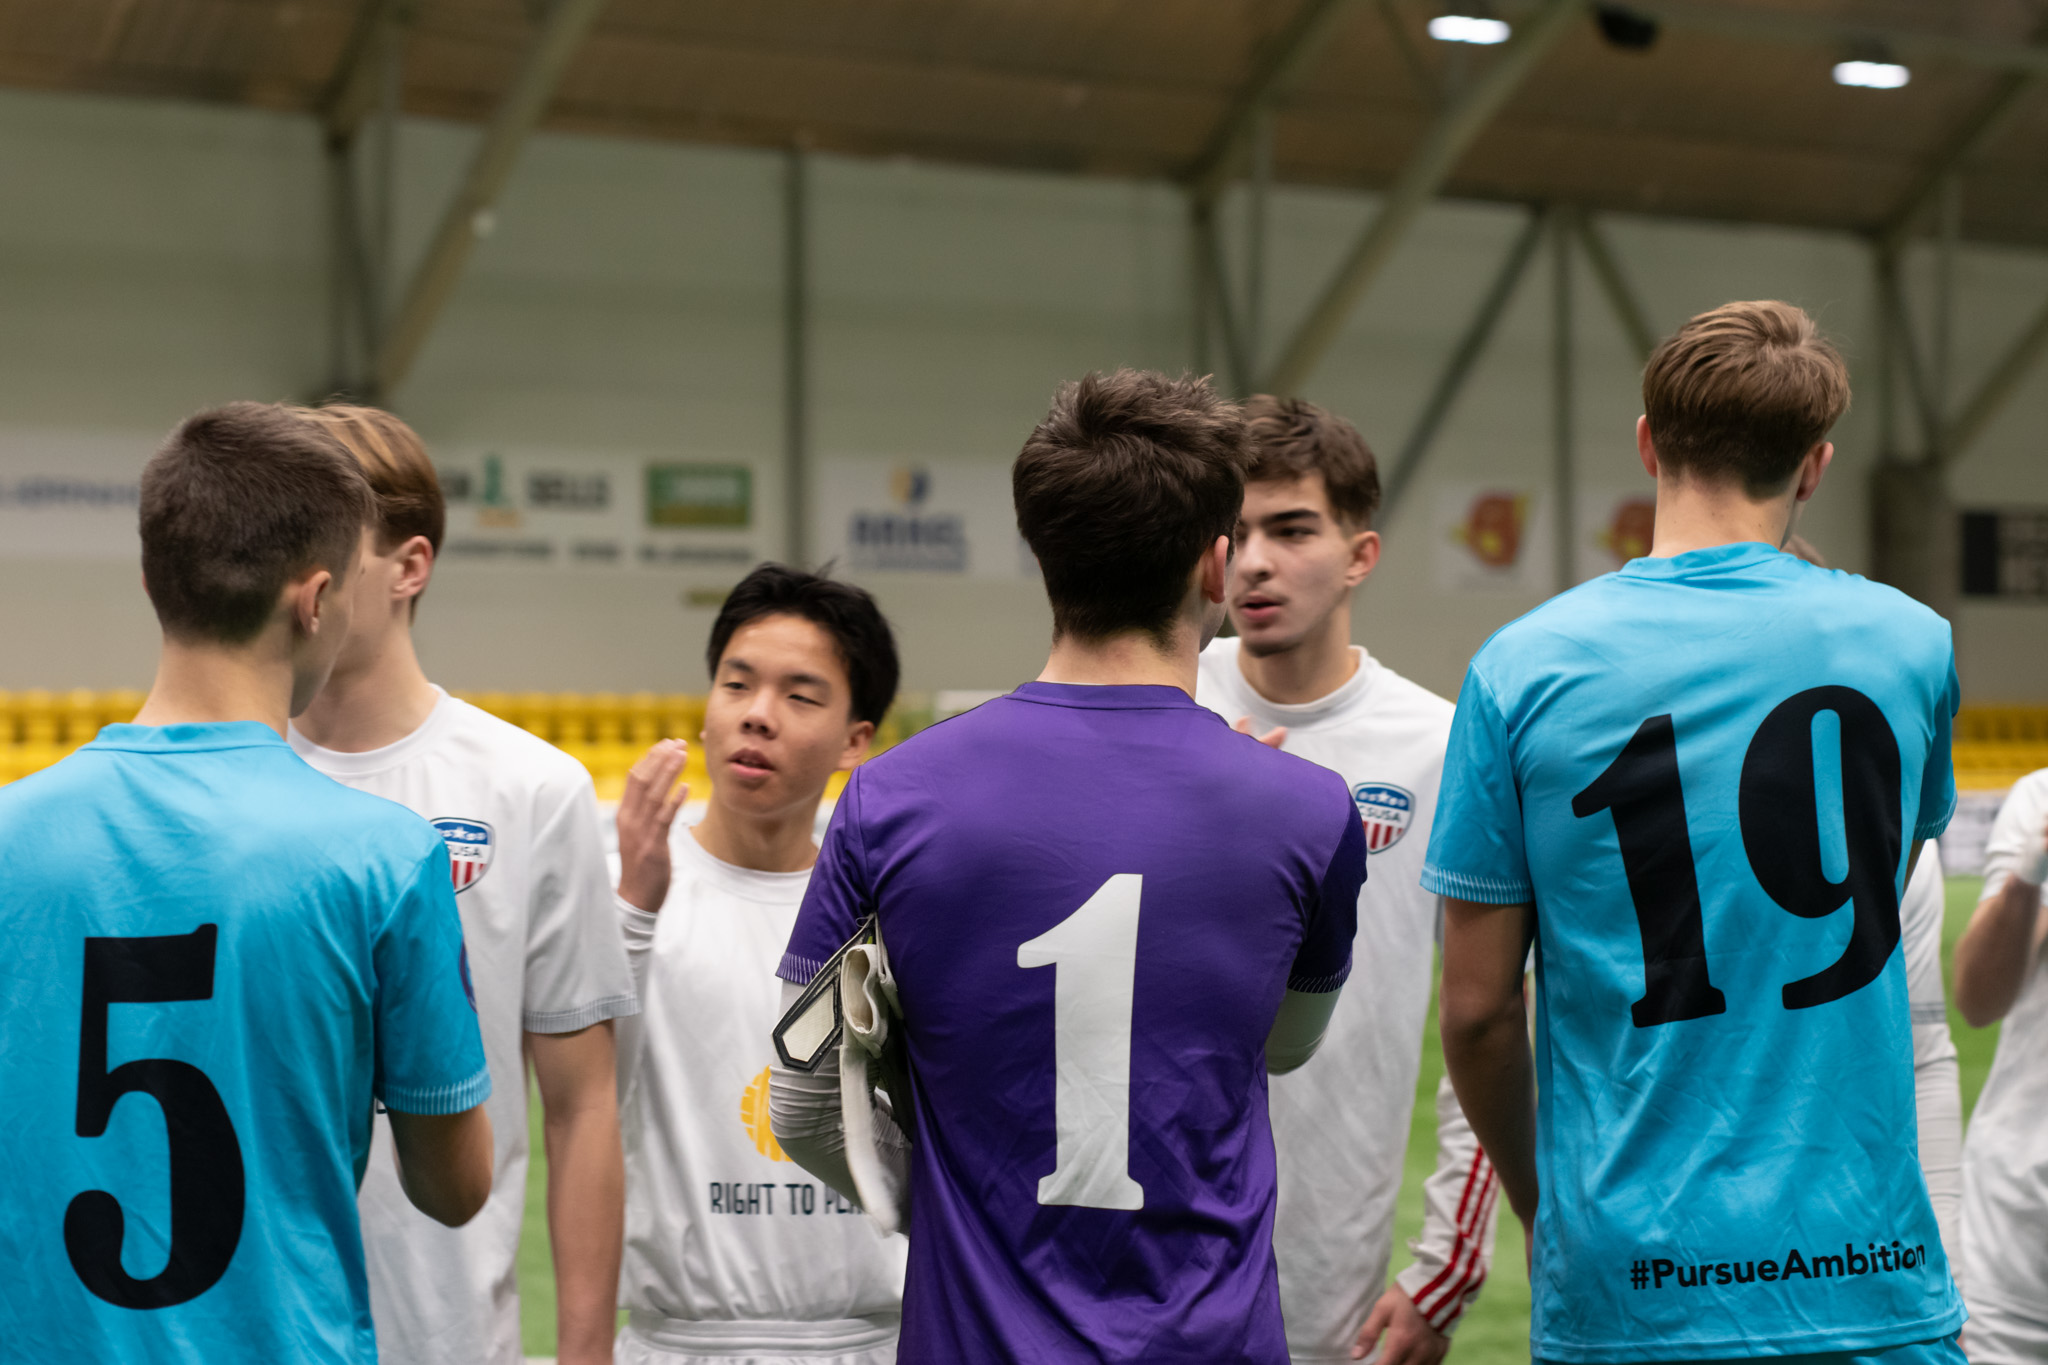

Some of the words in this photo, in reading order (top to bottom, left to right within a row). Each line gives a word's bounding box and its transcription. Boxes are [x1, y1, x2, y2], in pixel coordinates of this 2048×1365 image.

[1572, 685, 1901, 1028] 19
[64, 923, 245, 1310] 5
[710, 1182, 776, 1214] RIGHT
[784, 1183, 815, 1215] TO
[823, 1184, 863, 1215] PL
[1017, 873, 1144, 1210] 1
[1630, 1240, 1926, 1290] #PursueAmbition
